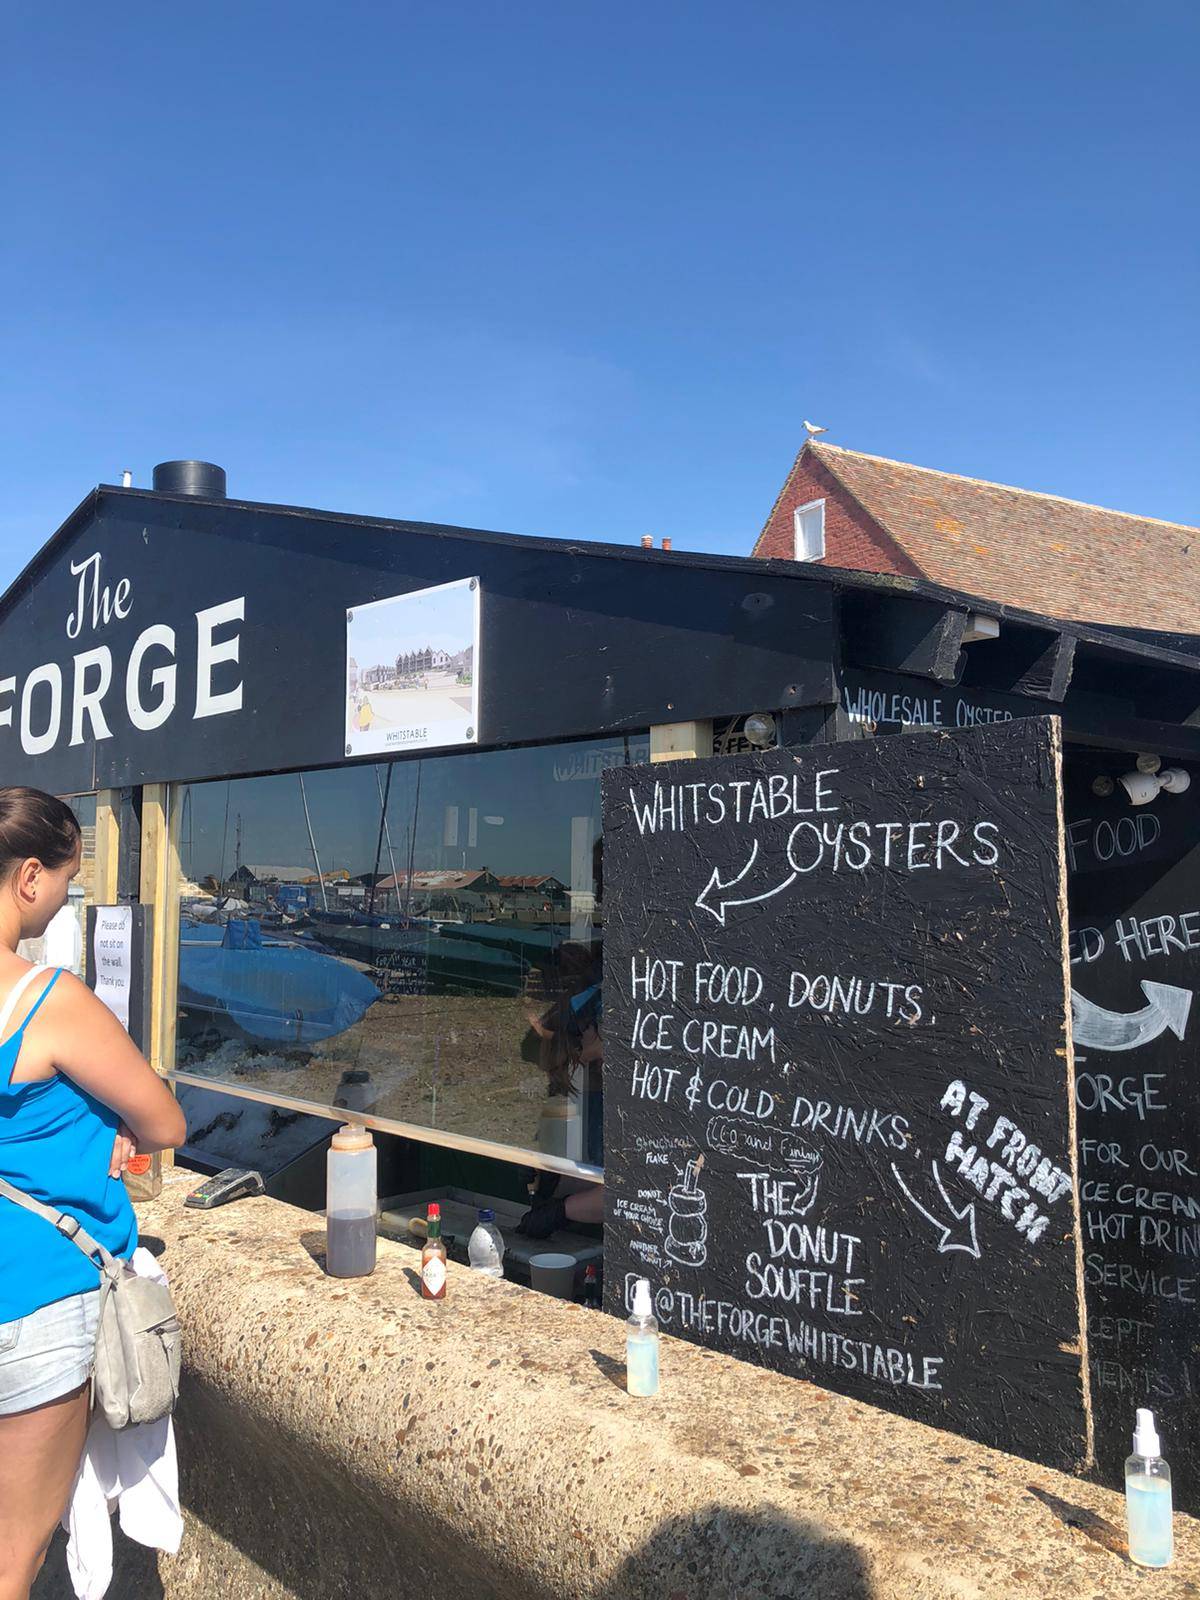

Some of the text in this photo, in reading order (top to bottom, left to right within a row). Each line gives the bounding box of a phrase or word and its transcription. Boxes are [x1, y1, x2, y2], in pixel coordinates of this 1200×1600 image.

[66, 552, 133, 639] The
[844, 687, 942, 725] WHOLESALE
[386, 728, 428, 741] WHITSTABLE
[630, 769, 840, 836] WHITSTABLE
[786, 821, 1000, 873] OYSTERS
[1066, 814, 1161, 872] FOOD
[100, 940, 109, 949] not
[117, 940, 124, 949] on
[102, 921, 117, 930] Please
[1115, 911, 1200, 962] HERE
[101, 975, 114, 986] Thank
[102, 957, 111, 967] the
[631, 956, 684, 1001] HOT
[631, 1008, 674, 1049] ICE
[631, 1060, 682, 1103] HOT
[685, 1066, 703, 1110] &
[707, 1079, 774, 1118] COLD
[1074, 1056, 1167, 1121] ORGE
[743, 1134, 773, 1152] and
[940, 1079, 1073, 1204] AT FRONT
[1079, 1138, 1198, 1177] FOR OUR
[616, 1199, 657, 1217] ICE CREAM
[736, 1172, 796, 1217] THE
[945, 1130, 1050, 1244] HATCH
[1078, 1178, 1110, 1202] CE
[763, 1219, 861, 1274] DONUT
[1087, 1210, 1200, 1258] HOT DRIN
[745, 1253, 866, 1316] SOUFFLE
[1085, 1252, 1197, 1303] SERVICE
[655, 1287, 944, 1389] @THEFORGEWHITSTABLE
